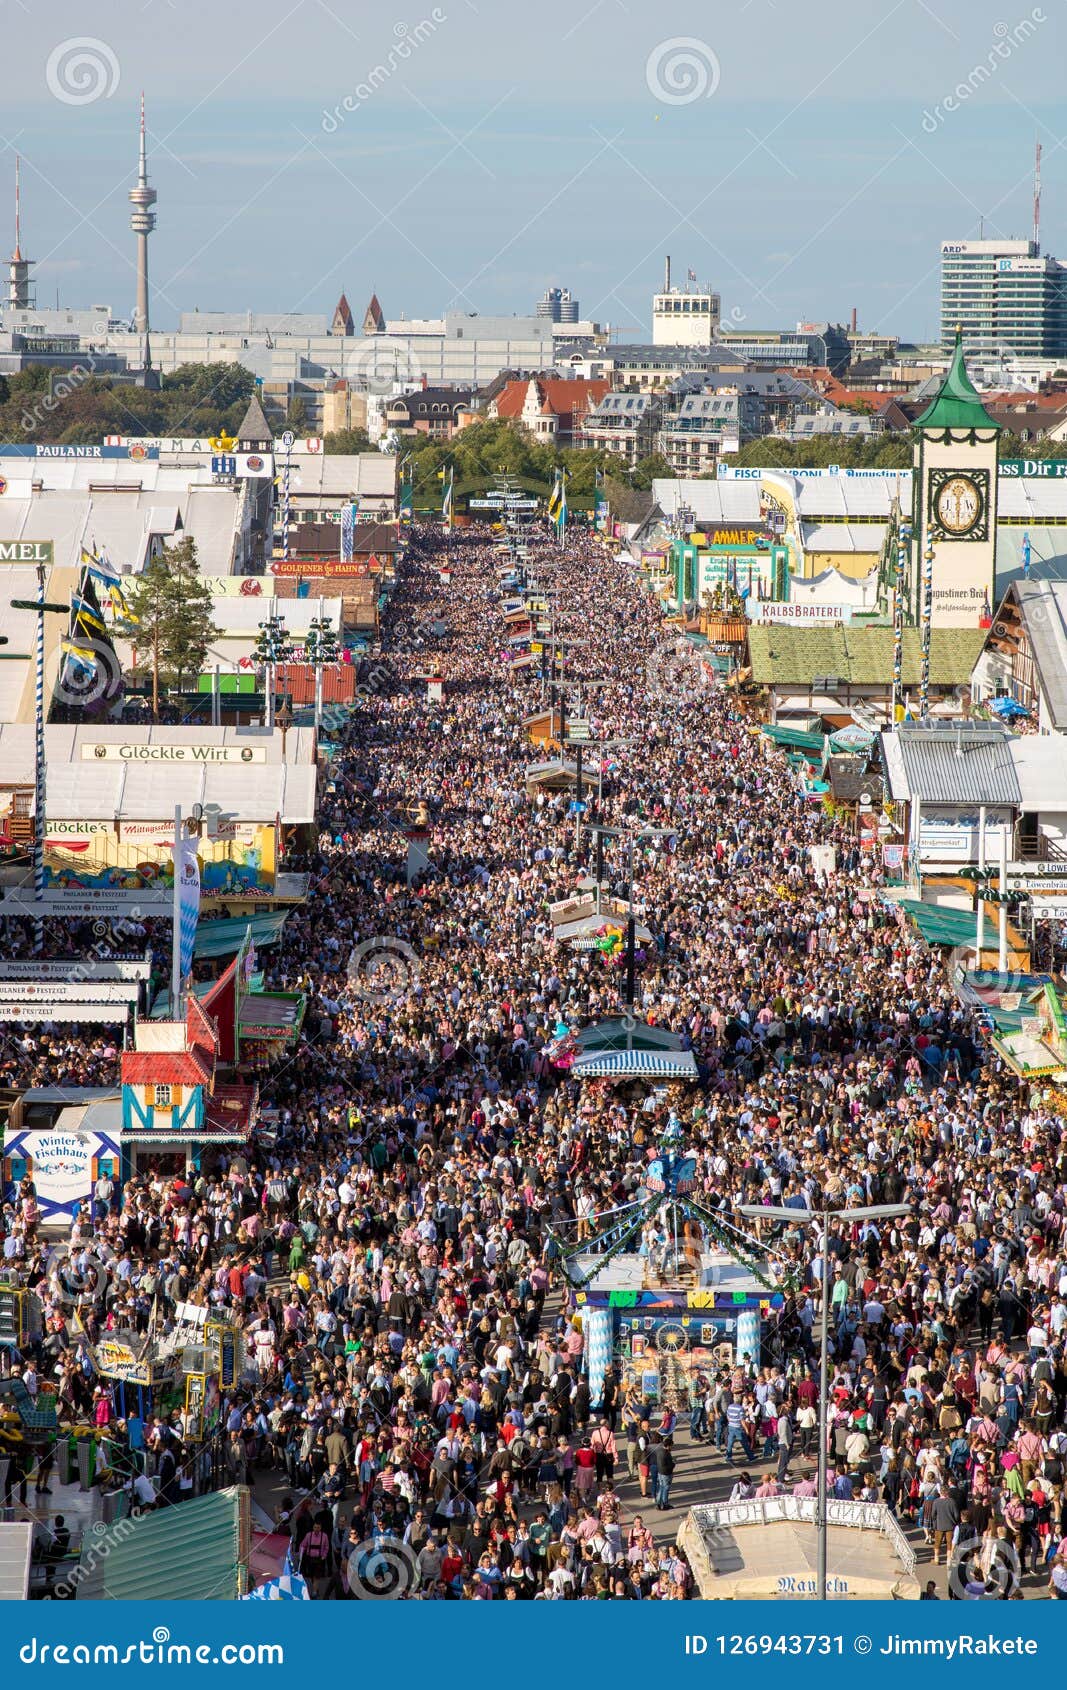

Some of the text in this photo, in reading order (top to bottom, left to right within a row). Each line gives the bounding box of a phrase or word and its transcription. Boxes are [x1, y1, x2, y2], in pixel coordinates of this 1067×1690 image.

[36, 445, 101, 457] PAULANER
[1023, 460, 1052, 476] Dir
[713, 530, 754, 545] AMMER
[281, 564, 358, 573] GOLDENER HAHN
[119, 745, 229, 761] Glöckle Wirt
[38, 1136, 85, 1148] Winter's
[34, 1146, 88, 1160] Fischhaus
